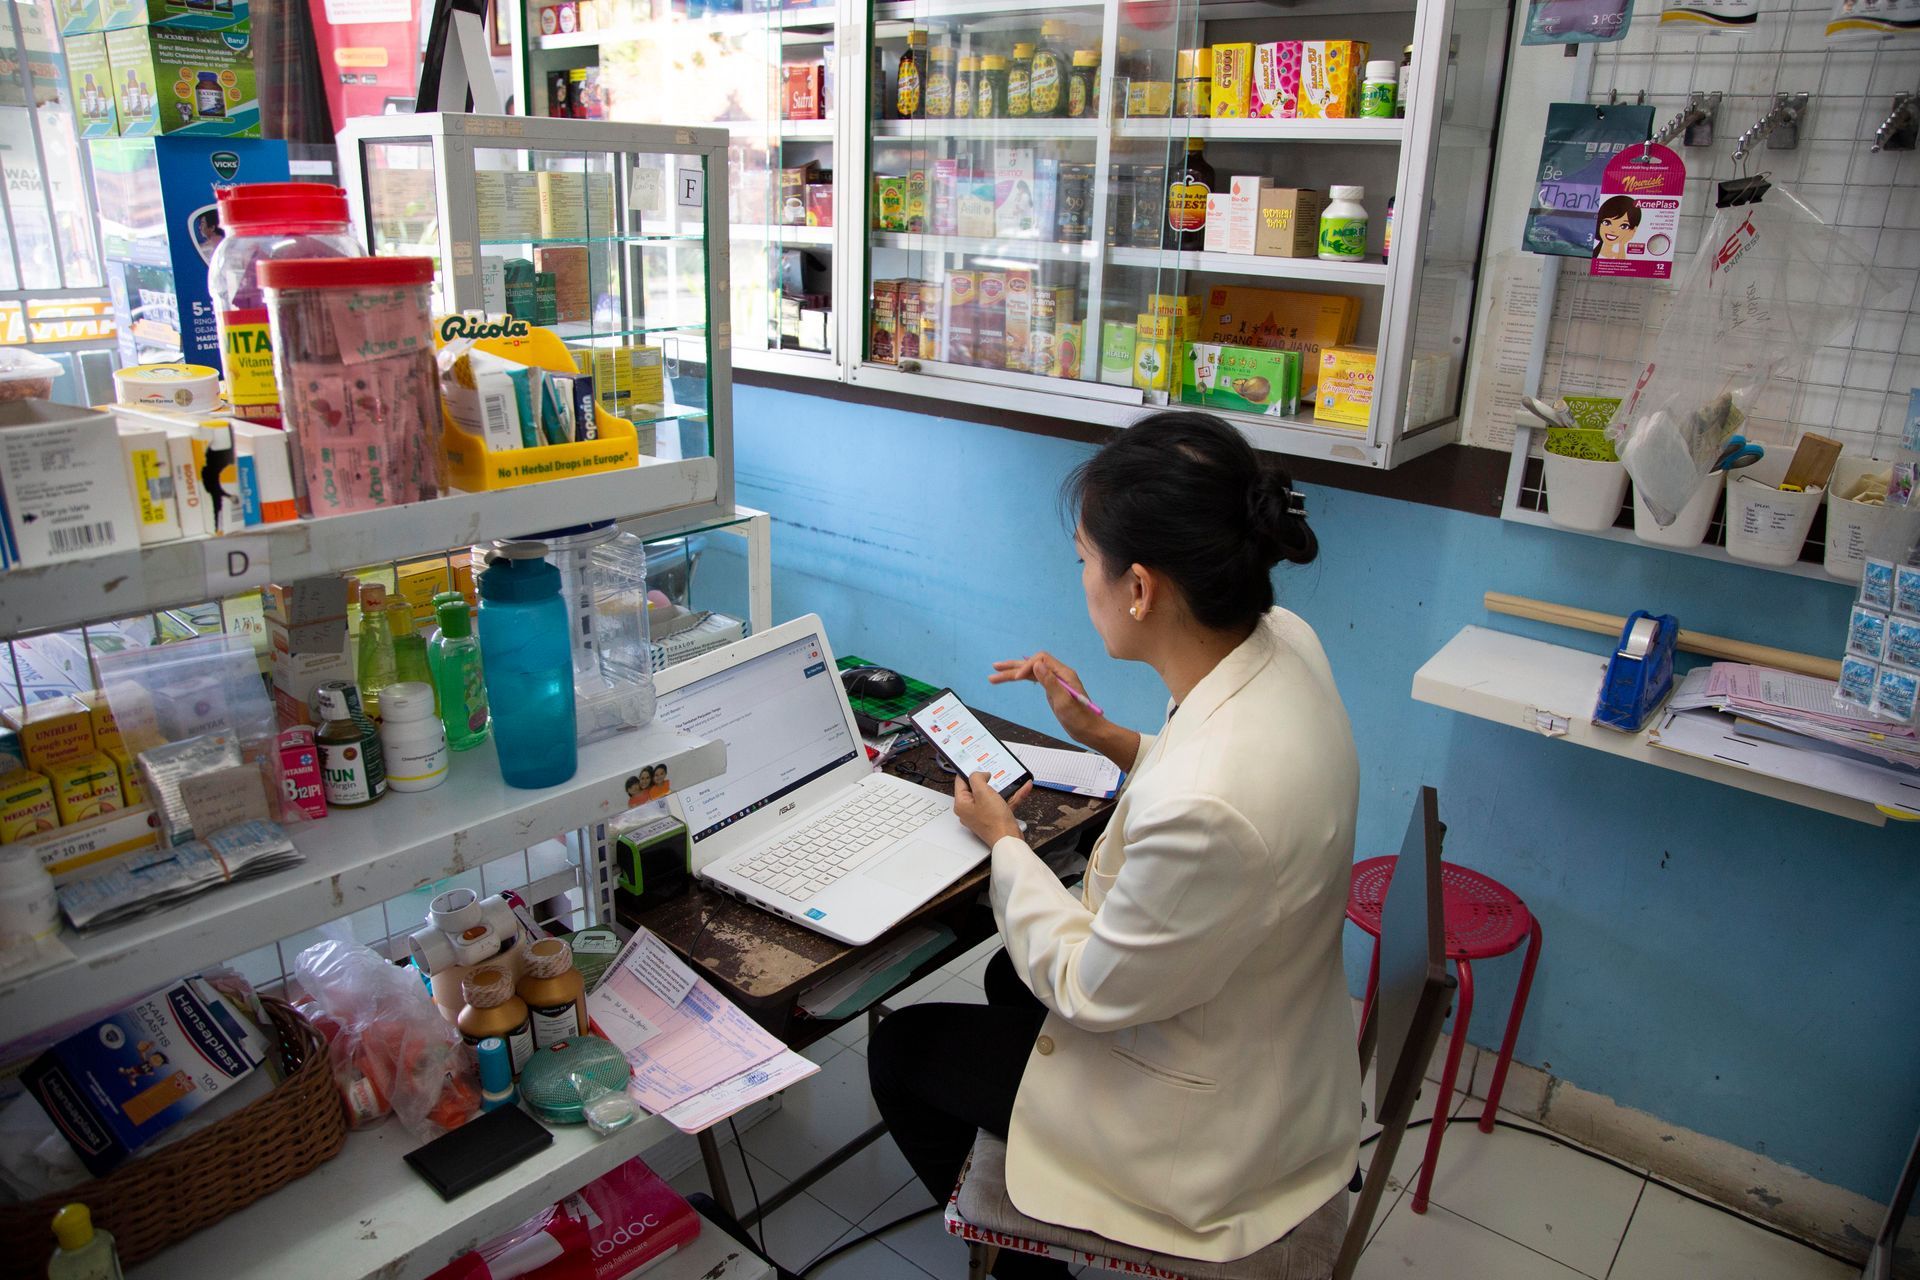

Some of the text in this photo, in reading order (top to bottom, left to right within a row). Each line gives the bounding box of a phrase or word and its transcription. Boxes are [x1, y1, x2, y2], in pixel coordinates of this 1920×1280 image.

[1592, 13, 1624, 25] 3 PCS
[792, 91, 813, 109] Sutra
[1543, 166, 1563, 181] Be
[1621, 174, 1665, 192] Nourish
[685, 178, 697, 200] F
[1635, 200, 1677, 209] AcnePlast
[1587, 233, 1593, 242] 3
[1723, 231, 1761, 274] express
[441, 314, 529, 342] Ricola
[1213, 332, 1253, 345] FUFANG
[1290, 341, 1319, 353] JIANG
[583, 394, 599, 442] aporin
[498, 467, 511, 479] No
[521, 460, 553, 476] Herbal
[555, 456, 581, 473] Drops
[583, 455, 592, 467] in
[227, 551, 249, 577] D
[62, 732, 90, 748] syrup
[284, 765, 313, 777] VITAMIN
[68, 785, 117, 804] NEGATAL
[3, 802, 51, 822] NEGATAL
[779, 802, 796, 816] ASUS
[62, 840, 96, 859] 10 mg
[146, 1001, 168, 1028] KAIN
[137, 1005, 170, 1049] ELASTIS
[175, 993, 240, 1073] Hansaplast
[201, 1072, 218, 1092] 100
[49, 1079, 101, 1147] Hansaplast
[592, 1213, 660, 1261] lodoc
[950, 1219, 1050, 1256] FRAGILE
[613, 1241, 649, 1264] healthcare
